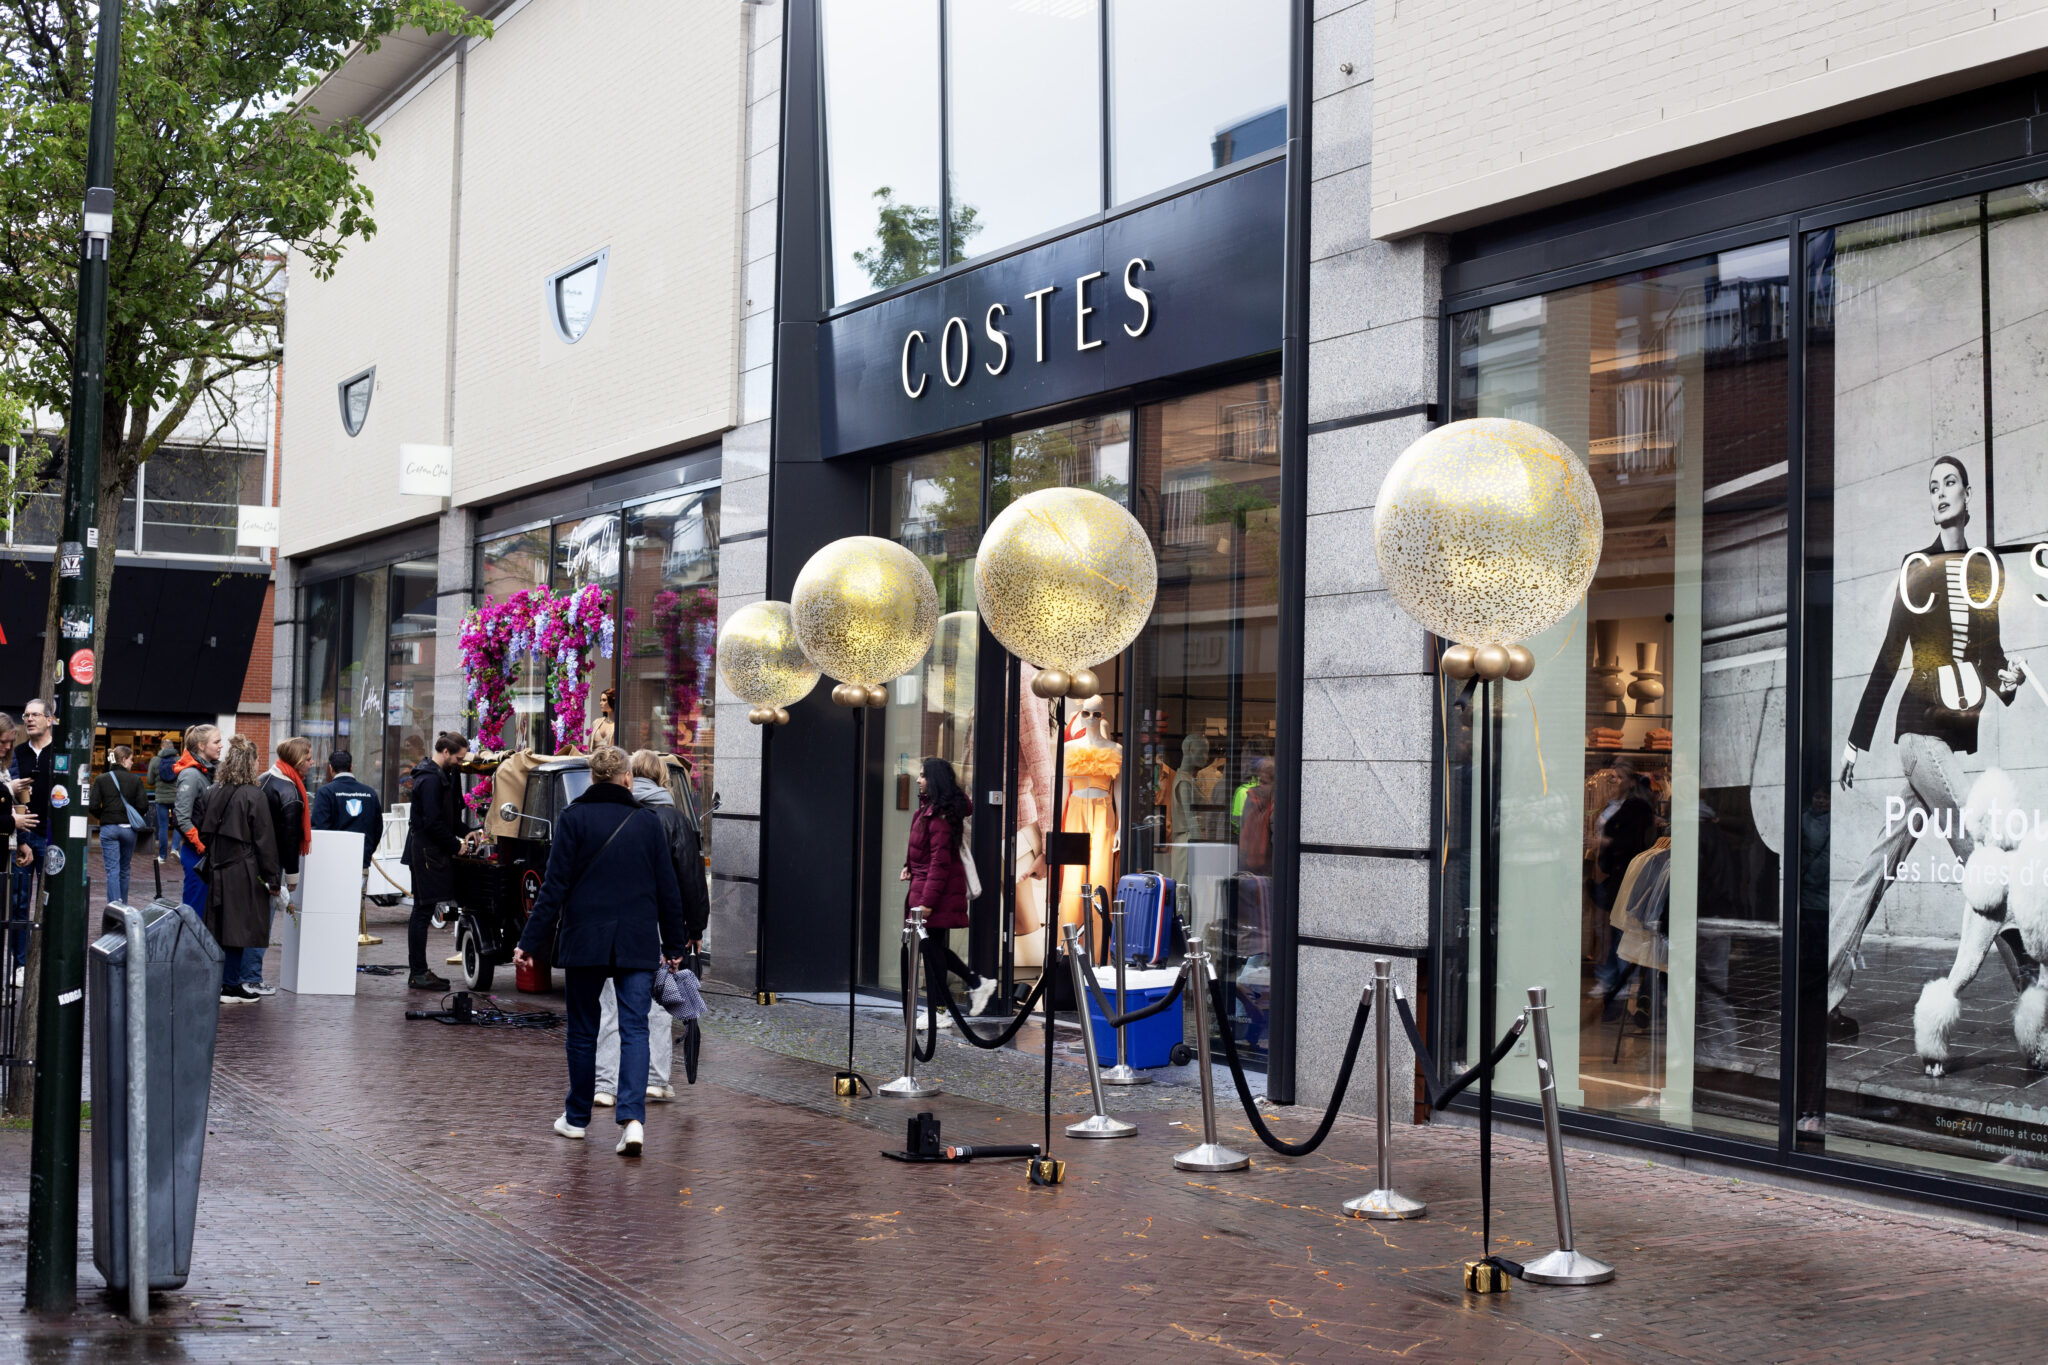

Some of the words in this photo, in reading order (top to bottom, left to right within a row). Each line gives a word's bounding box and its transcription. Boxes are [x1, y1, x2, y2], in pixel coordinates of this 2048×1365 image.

[902, 258, 1152, 398] COSTES
[1886, 796, 1973, 839] Pour
[1884, 854, 1920, 881] Les
[1936, 1116, 1957, 1131] Shop
[1961, 1120, 1983, 1132] 24/7
[1986, 1126, 2015, 1138] online
[2018, 1130, 2027, 1139] at
[1975, 1140, 1996, 1152] Free
